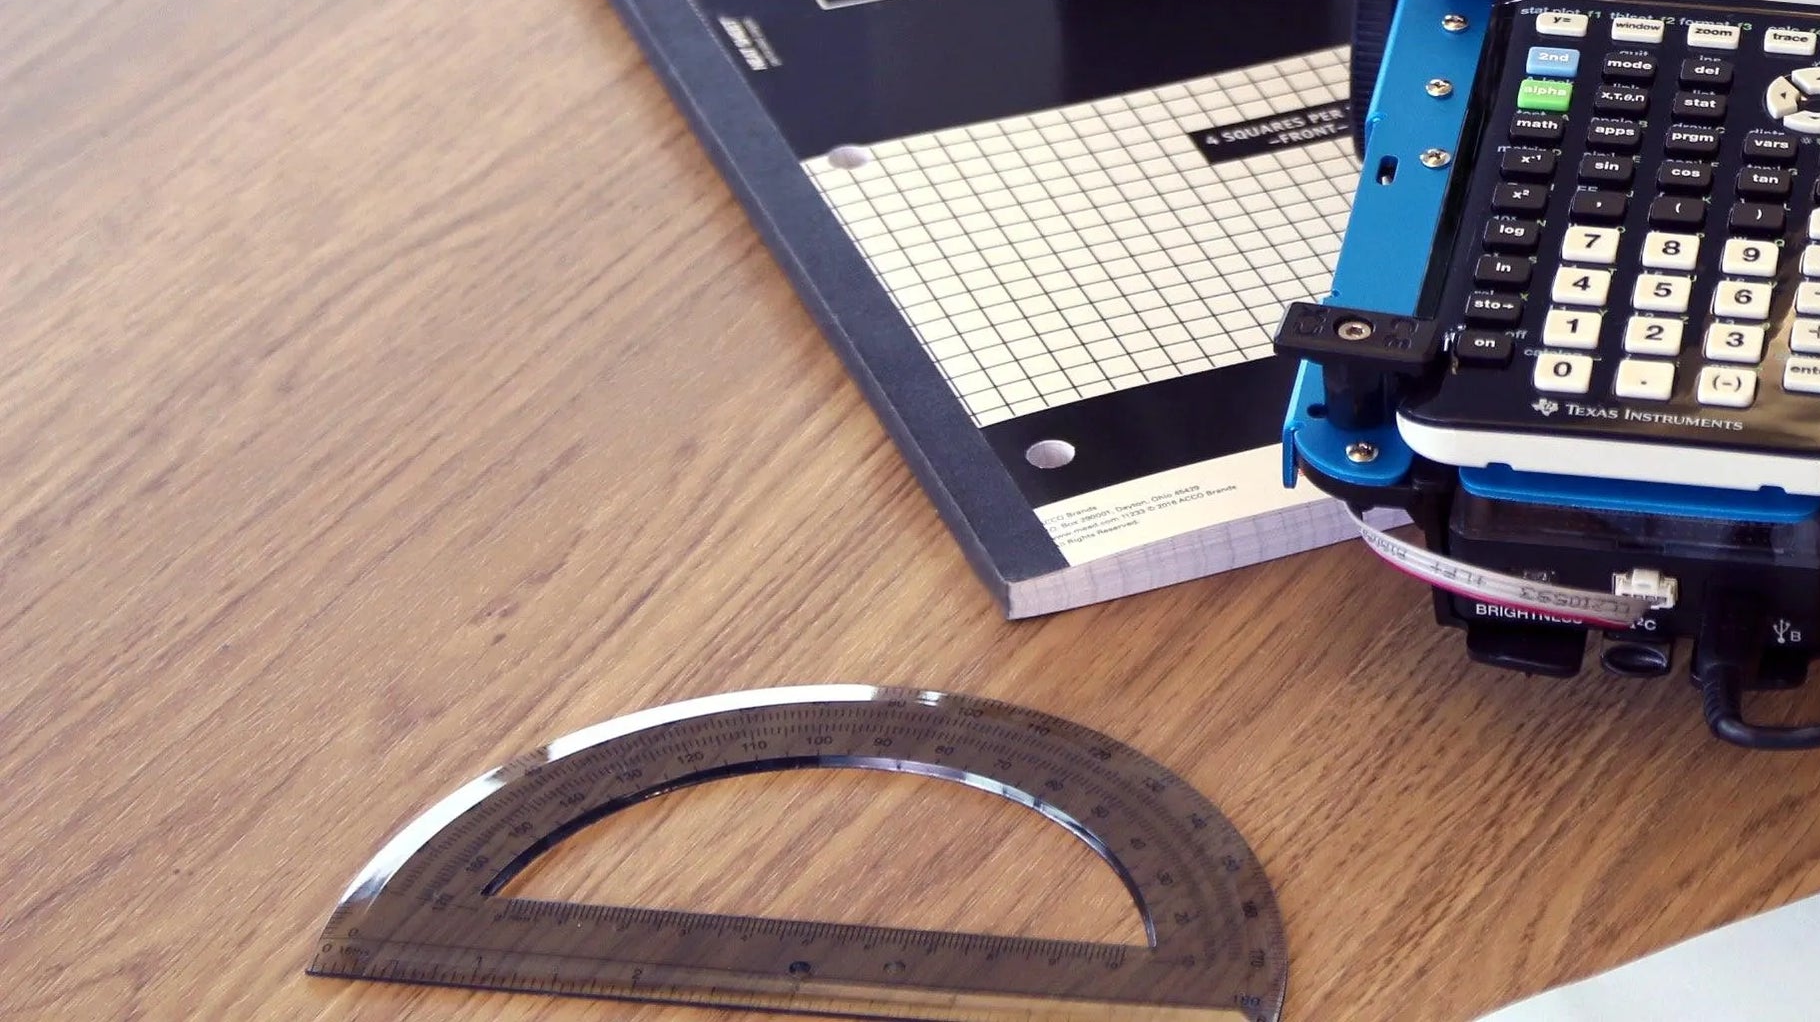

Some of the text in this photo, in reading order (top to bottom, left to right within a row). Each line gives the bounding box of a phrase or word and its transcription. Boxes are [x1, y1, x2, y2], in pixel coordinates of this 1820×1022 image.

[1616, 21, 1661, 31] window
[1695, 28, 1733, 36] zoom
[1772, 33, 1809, 43] trace
[1538, 52, 1569, 62] 2nd
[1607, 60, 1652, 70] mode
[1694, 66, 1720, 76] del
[1523, 85, 1568, 96] alpha
[1683, 98, 1717, 108] stat
[1222, 116, 1306, 143] SQUARES
[1307, 108, 1344, 125] PER
[1516, 119, 1558, 130] math
[1594, 126, 1635, 136] apps
[1671, 132, 1714, 143] prgm
[1754, 139, 1789, 149] vars
[1594, 161, 1619, 171] sin
[1671, 168, 1701, 178] cos
[1752, 173, 1779, 184] tan
[1499, 224, 1525, 237] log
[1584, 233, 1601, 249] 7
[1662, 240, 1681, 256] 8
[1742, 247, 1760, 262] 9
[1496, 262, 1512, 273] ln
[1572, 275, 1591, 291] 4
[1653, 282, 1673, 298] 5
[1734, 289, 1753, 305] 6
[1566, 319, 1580, 334] 1
[1644, 325, 1664, 341] 2
[1474, 339, 1496, 348] on
[1725, 332, 1744, 348] 3
[1553, 361, 1572, 377] 0
[1565, 403, 1743, 431] TEXAS INSTRUMENTS
[1151, 493, 1172, 503] Ohio
[1791, 631, 1801, 642] B
[805, 735, 833, 746] 100
[872, 737, 894, 748] 90
[742, 740, 768, 753] 110
[677, 751, 705, 765] 120
[322, 944, 332, 954] 0
